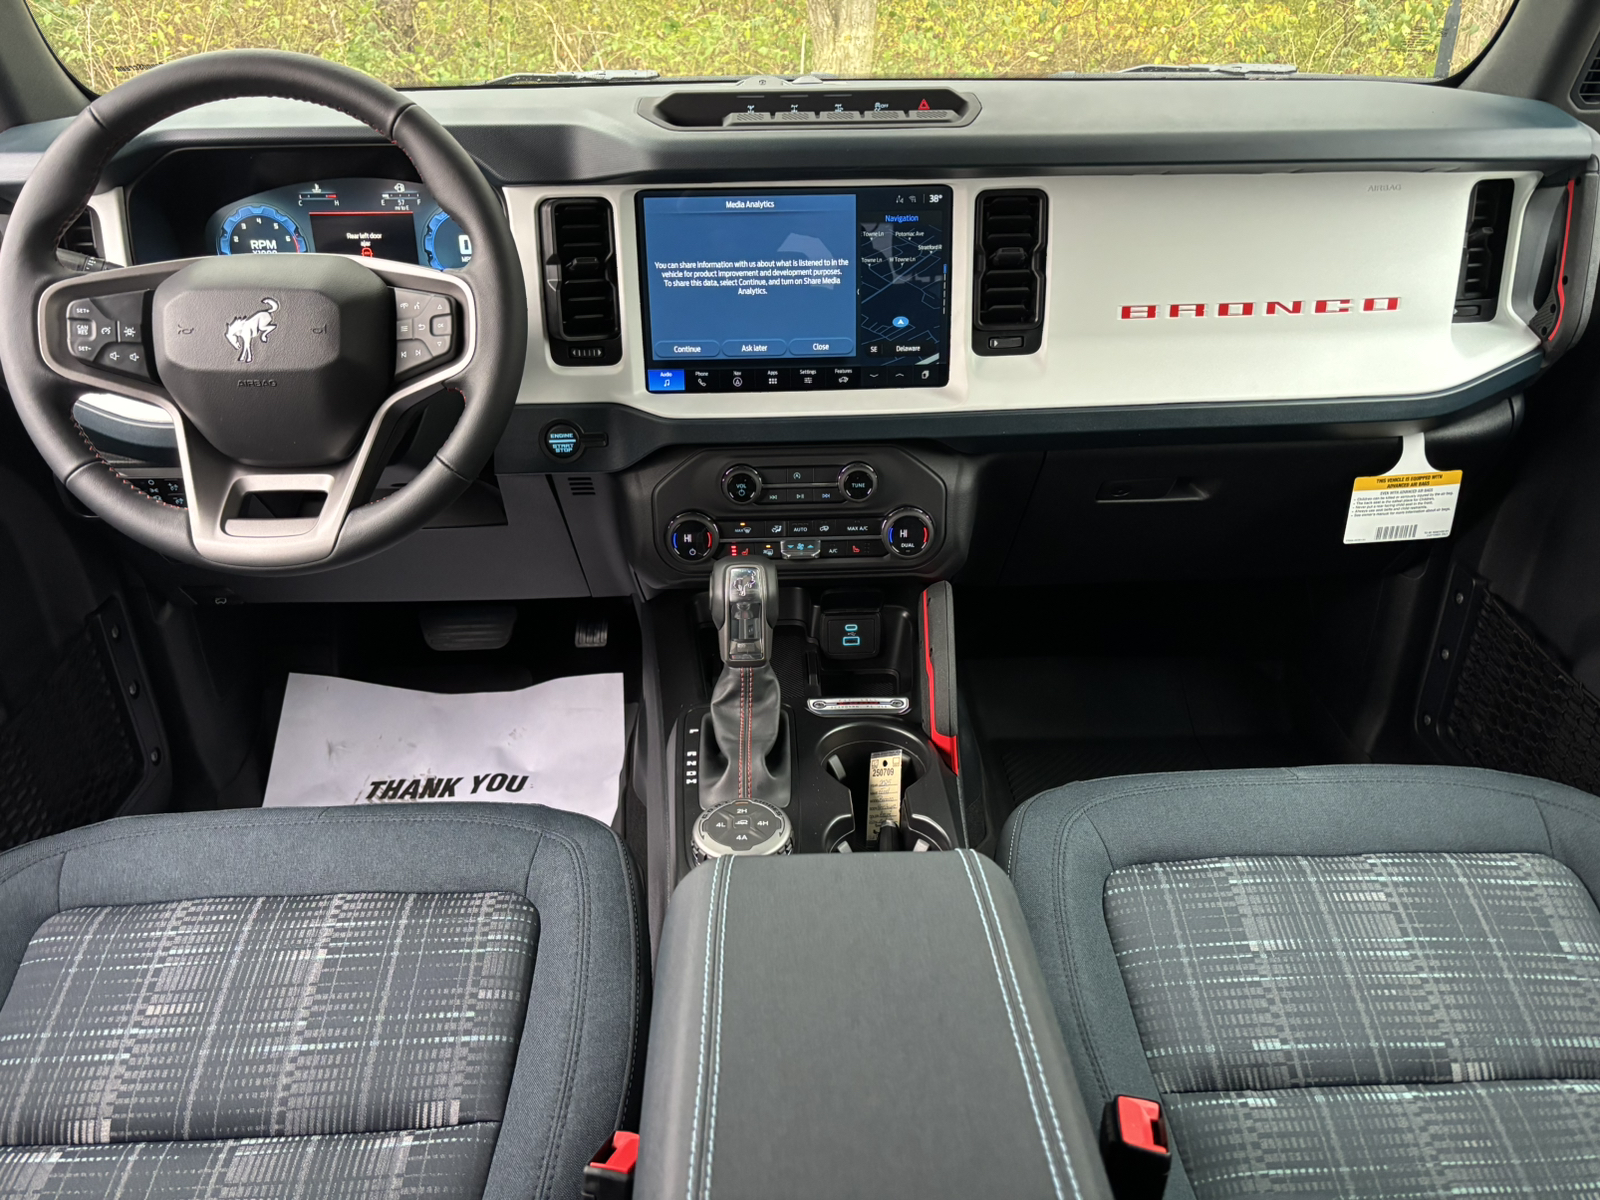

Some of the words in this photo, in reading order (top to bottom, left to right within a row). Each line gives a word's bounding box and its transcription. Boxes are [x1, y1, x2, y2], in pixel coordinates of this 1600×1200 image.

[1367, 184, 1402, 192] AIRBAG
[726, 200, 745, 208] Media
[746, 200, 774, 209] Analytics
[885, 214, 919, 223] Navigation
[250, 240, 277, 249] RPM
[694, 270, 717, 278] product
[718, 270, 759, 278] improvement
[772, 269, 812, 277] development
[1119, 297, 1400, 319] BRONCO
[684, 534, 692, 542] HI
[900, 529, 908, 538] HI
[872, 768, 894, 777] 250709
[366, 777, 464, 800] THANK
[470, 773, 529, 794] YOU
